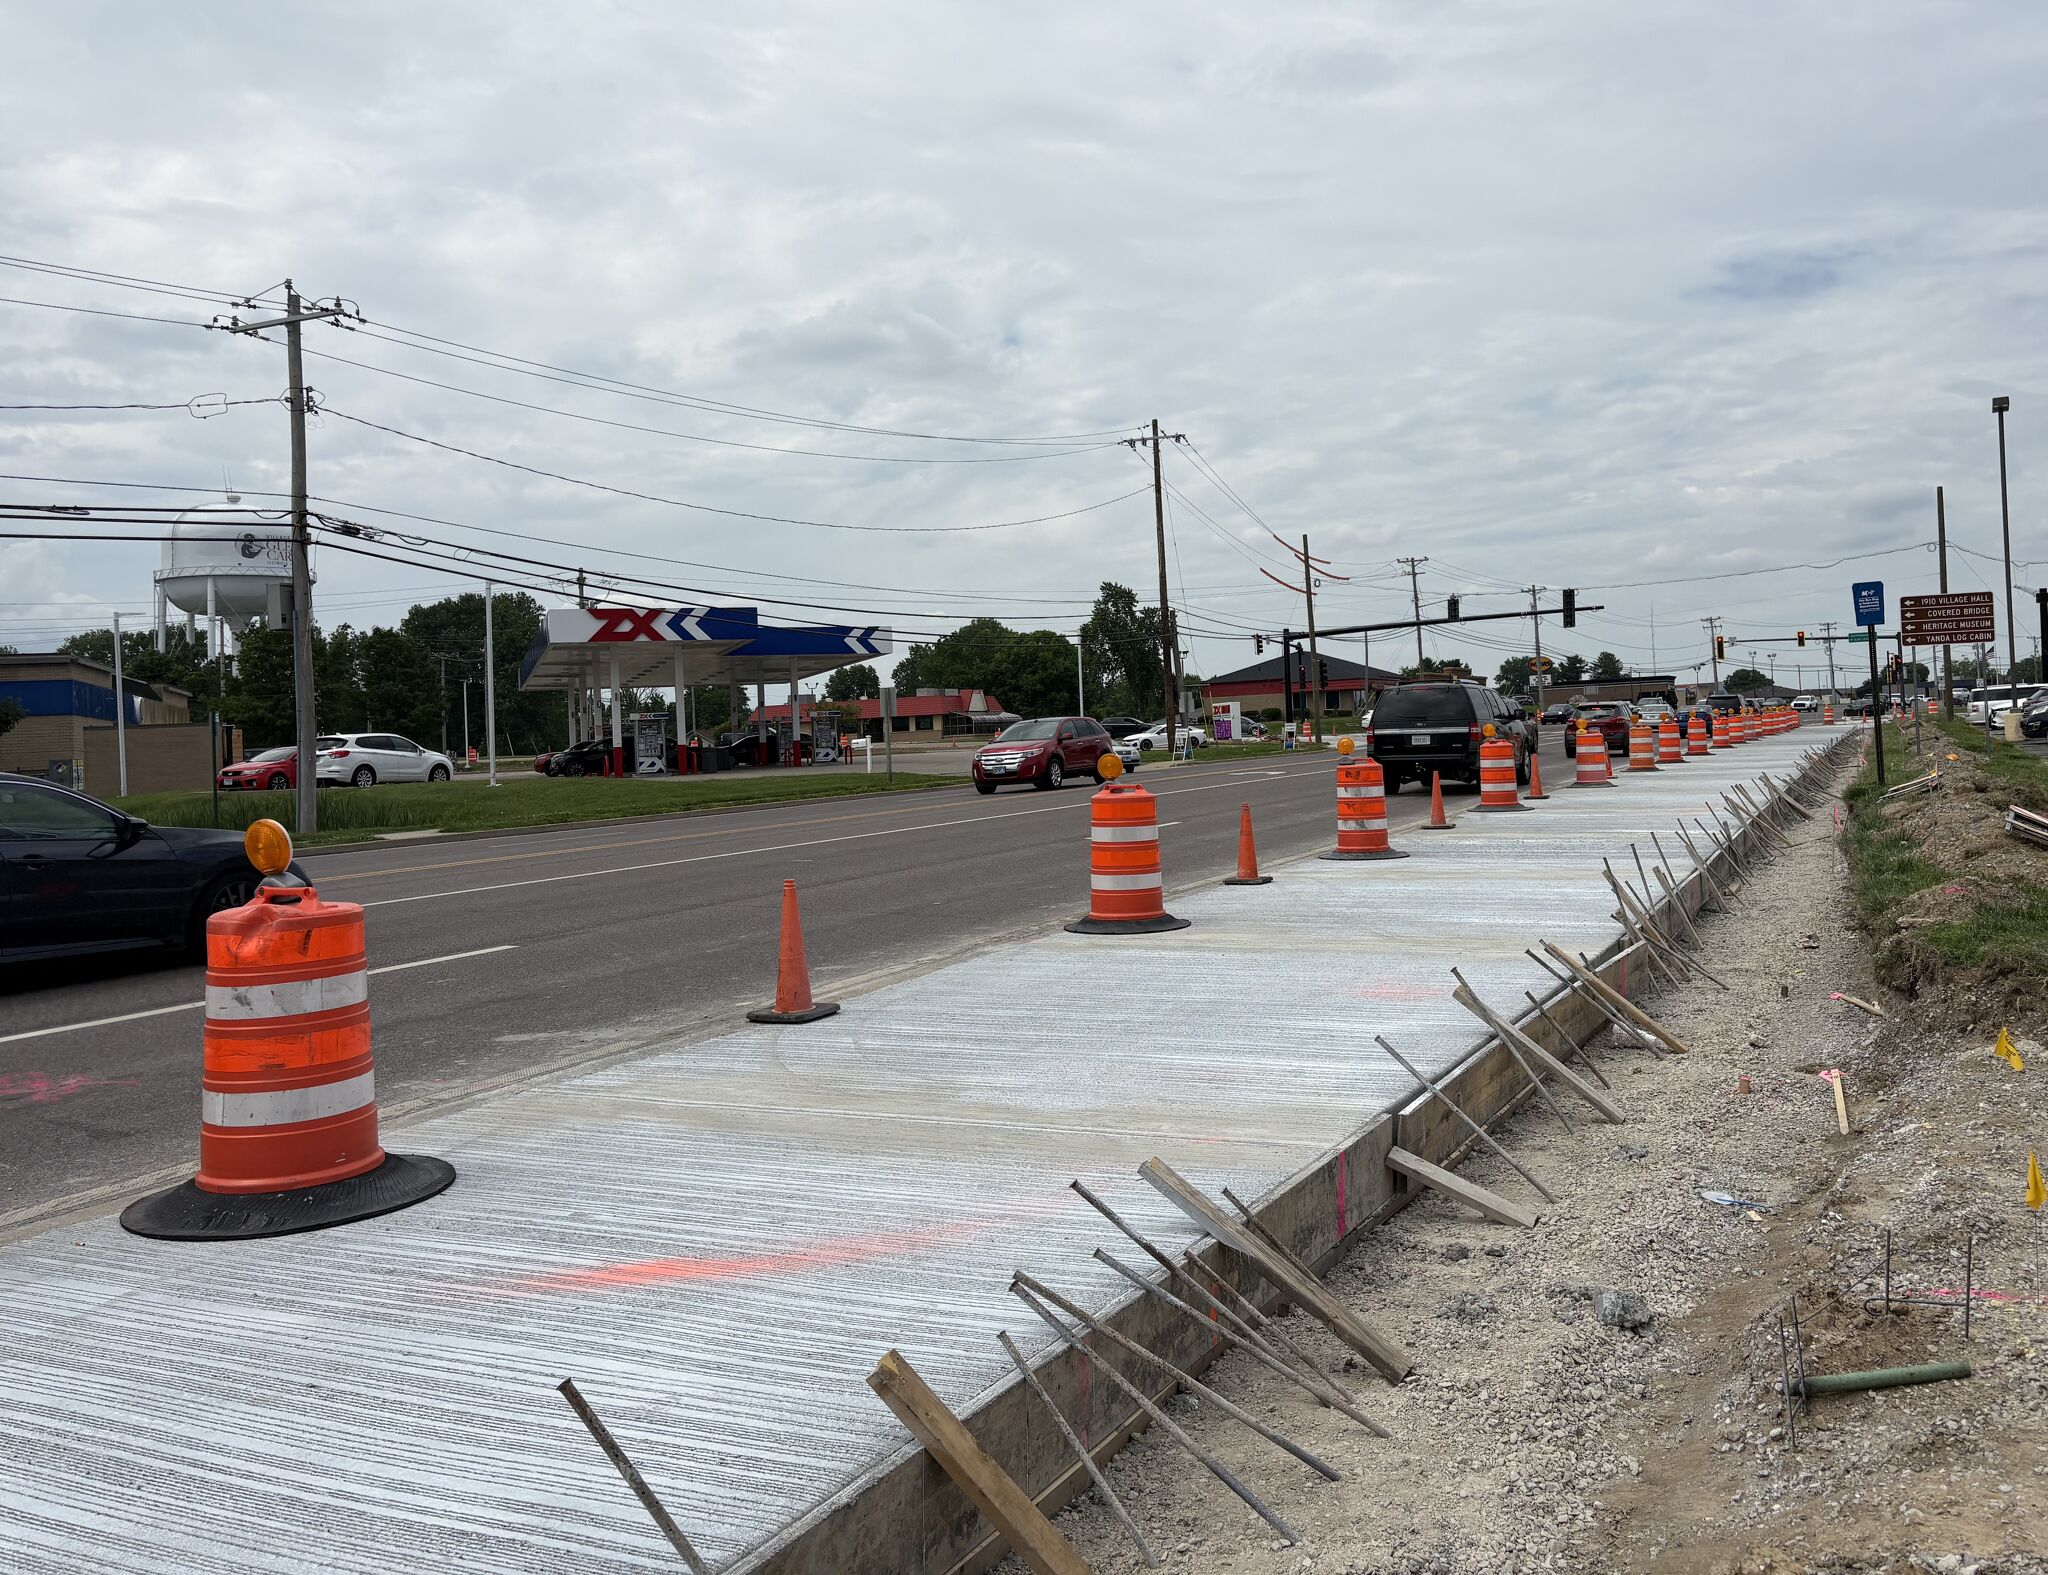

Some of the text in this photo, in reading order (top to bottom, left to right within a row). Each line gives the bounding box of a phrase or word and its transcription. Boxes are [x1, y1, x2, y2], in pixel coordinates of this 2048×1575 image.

[1938, 596, 1969, 604] VILLAGE
[1970, 594, 1990, 602] HALL
[1927, 607, 1991, 617] COVERED BRIDGE
[1922, 620, 1992, 630] HERITAGE MUSEUM
[1926, 632, 1992, 643] YANDA LOG CABIN
